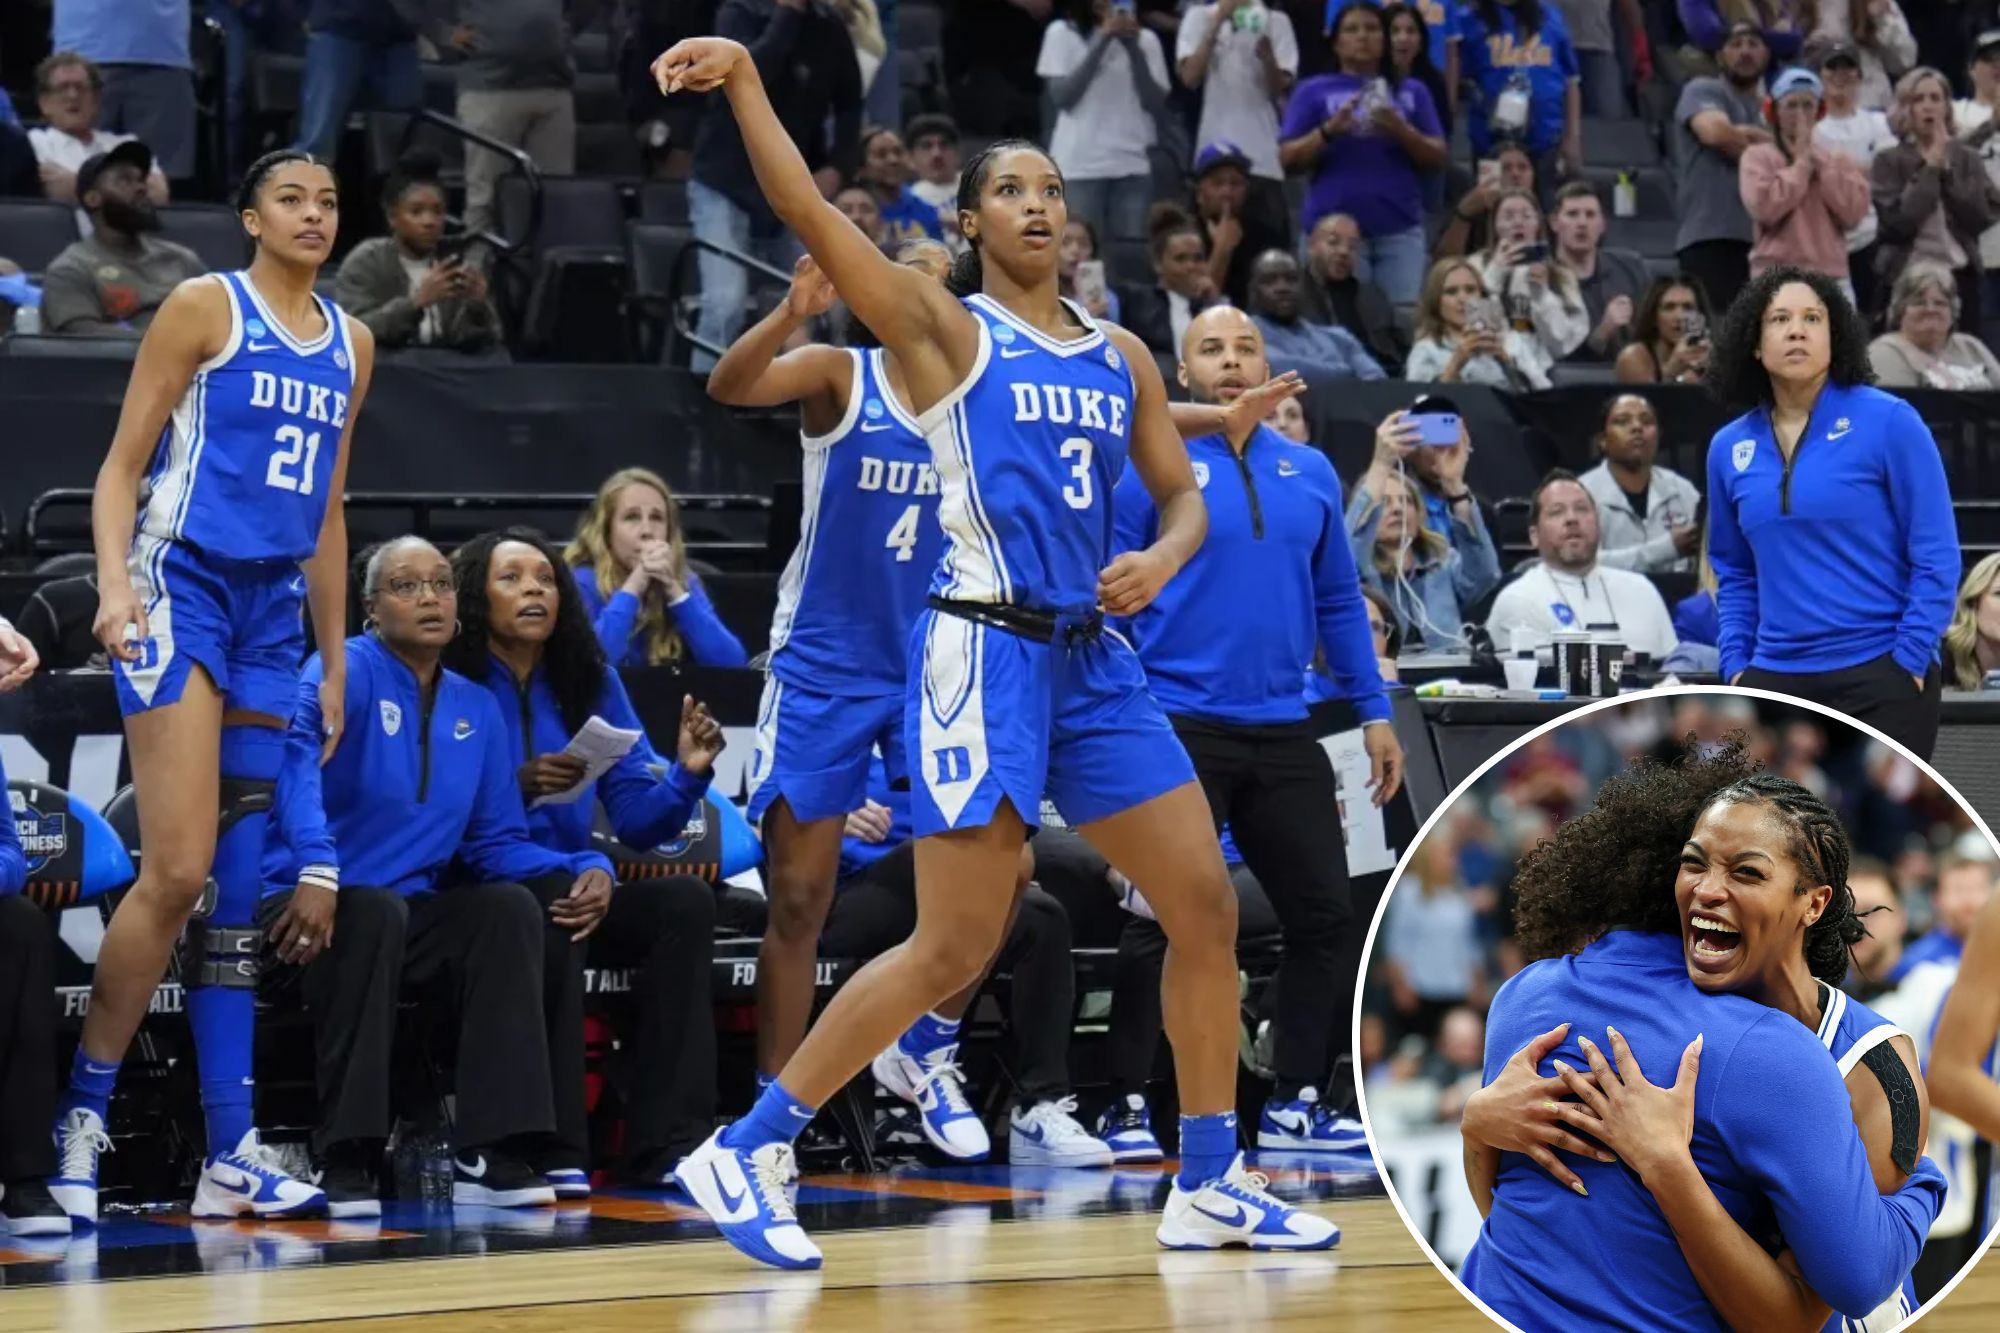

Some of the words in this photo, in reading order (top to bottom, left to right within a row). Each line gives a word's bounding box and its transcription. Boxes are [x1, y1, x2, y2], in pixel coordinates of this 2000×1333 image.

[250, 371, 347, 429] DUKE
[1009, 383, 1126, 437] DUKE
[265, 424, 321, 495] 21
[857, 456, 939, 496] DUK
[1060, 437, 1093, 509] 3
[885, 505, 921, 562] 4
[932, 746, 971, 786] D
[732, 963, 756, 985] FO
[814, 963, 833, 985] LL
[64, 991, 90, 1017] FO
